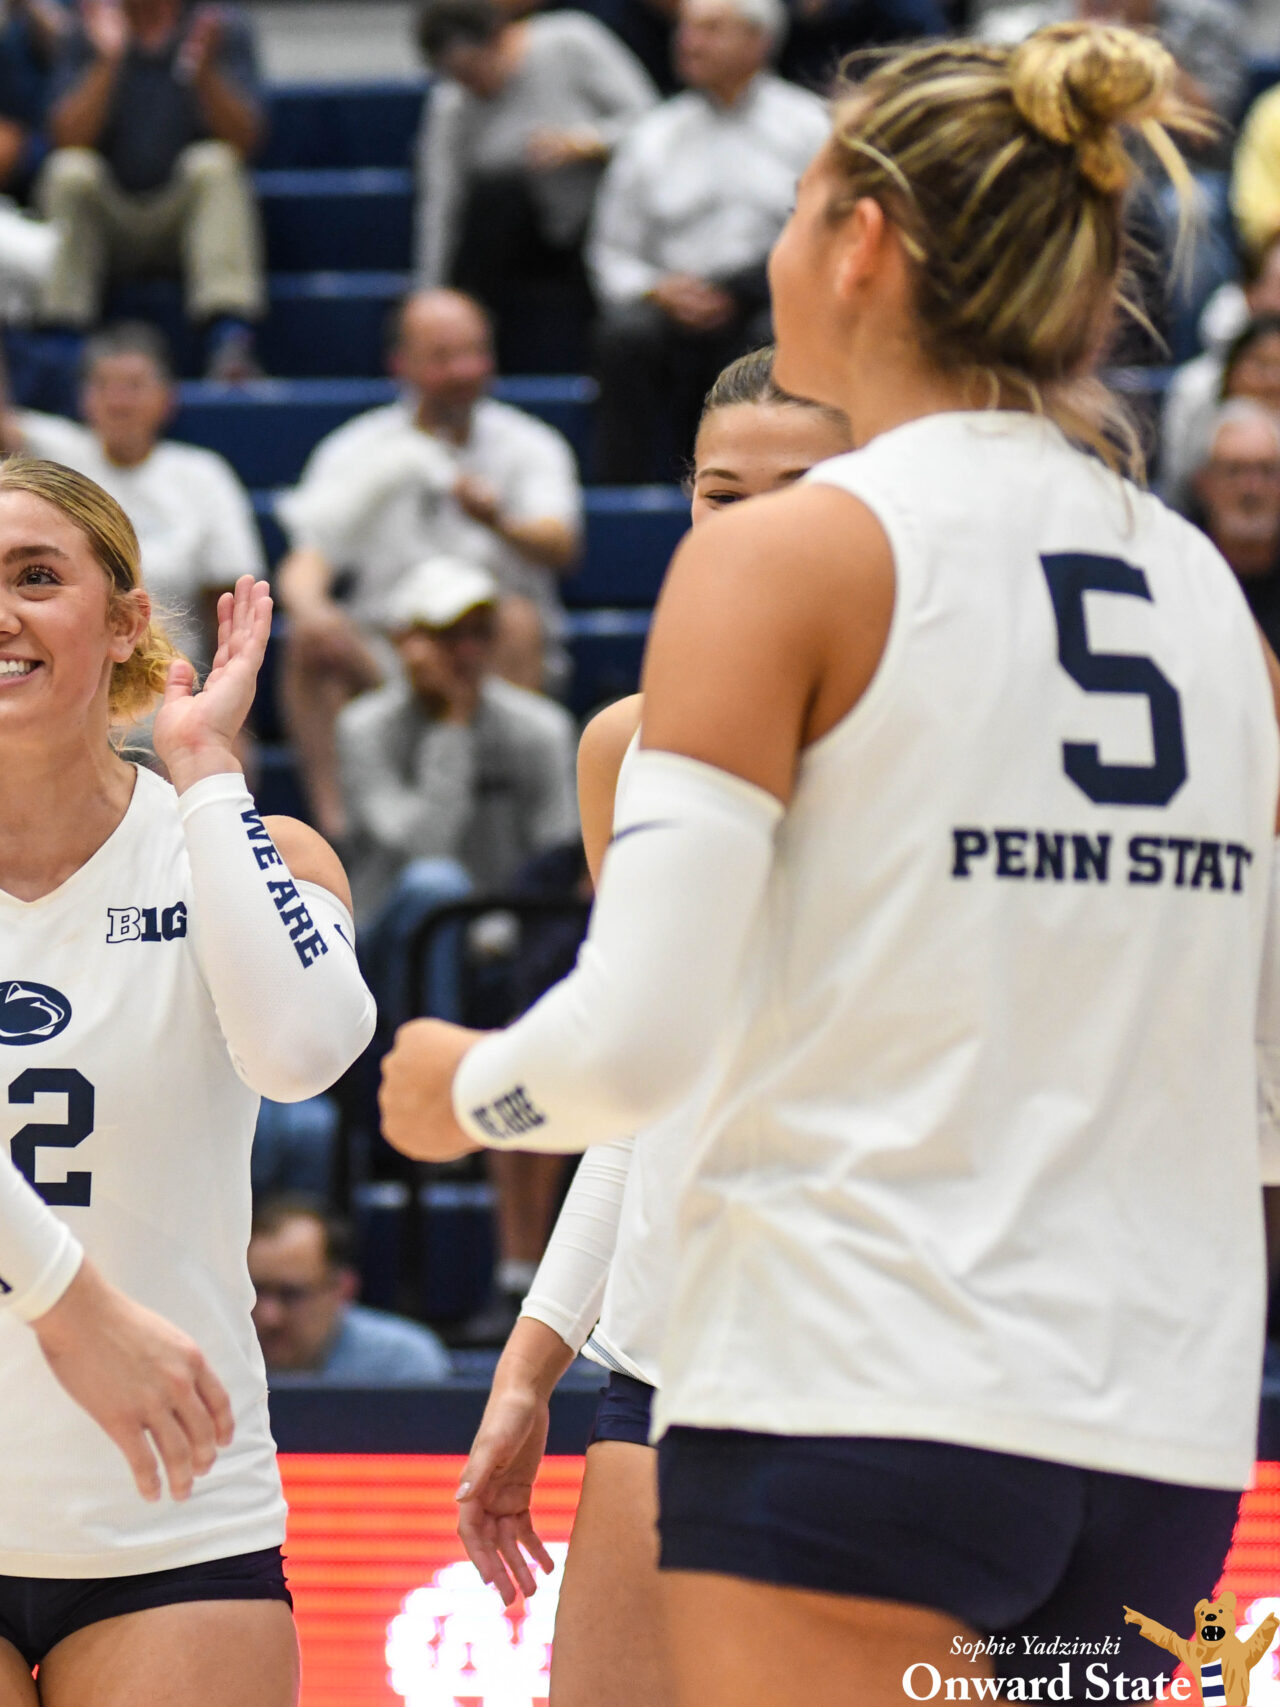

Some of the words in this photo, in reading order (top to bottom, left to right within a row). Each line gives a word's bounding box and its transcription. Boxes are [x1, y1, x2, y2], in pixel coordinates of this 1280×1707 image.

[1039, 551, 1189, 808] 5
[240, 809, 284, 871] WE
[266, 879, 329, 969] ARE
[951, 828, 1112, 883] PENN
[1127, 834, 1253, 893] STAT
